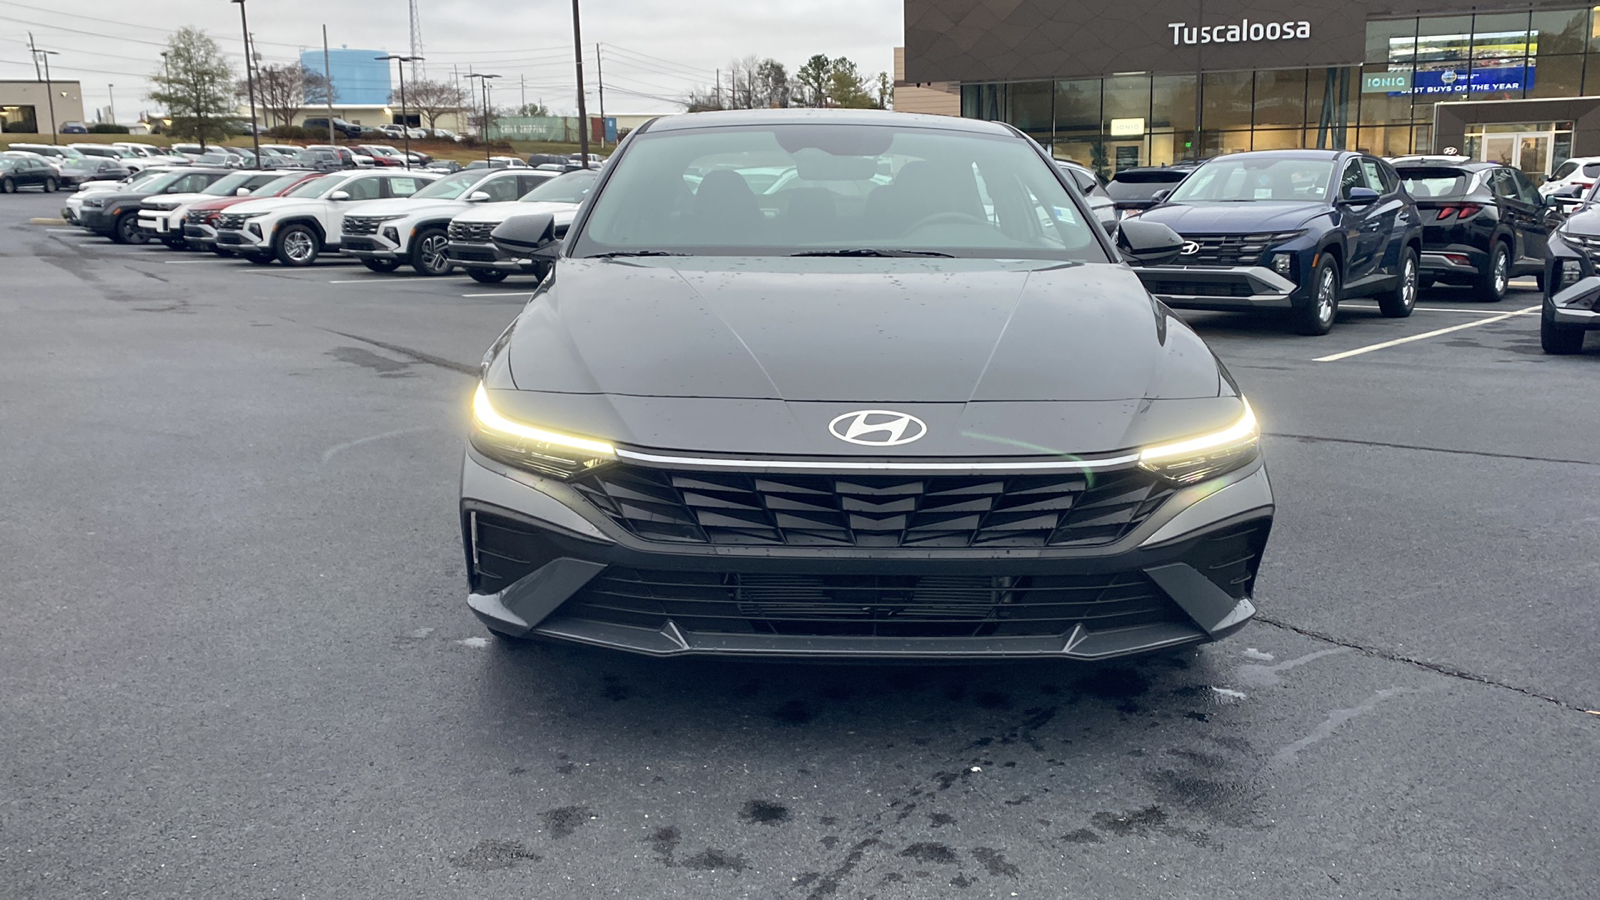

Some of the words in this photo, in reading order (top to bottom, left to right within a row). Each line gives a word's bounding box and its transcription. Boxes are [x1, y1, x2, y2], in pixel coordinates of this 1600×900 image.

[1168, 18, 1311, 45] Tuscaloosa
[1367, 77, 1405, 87] IONIQ
[1427, 85, 1452, 93] BUYS
[1470, 83, 1490, 91] THE
[1492, 82, 1519, 90] YEAR
